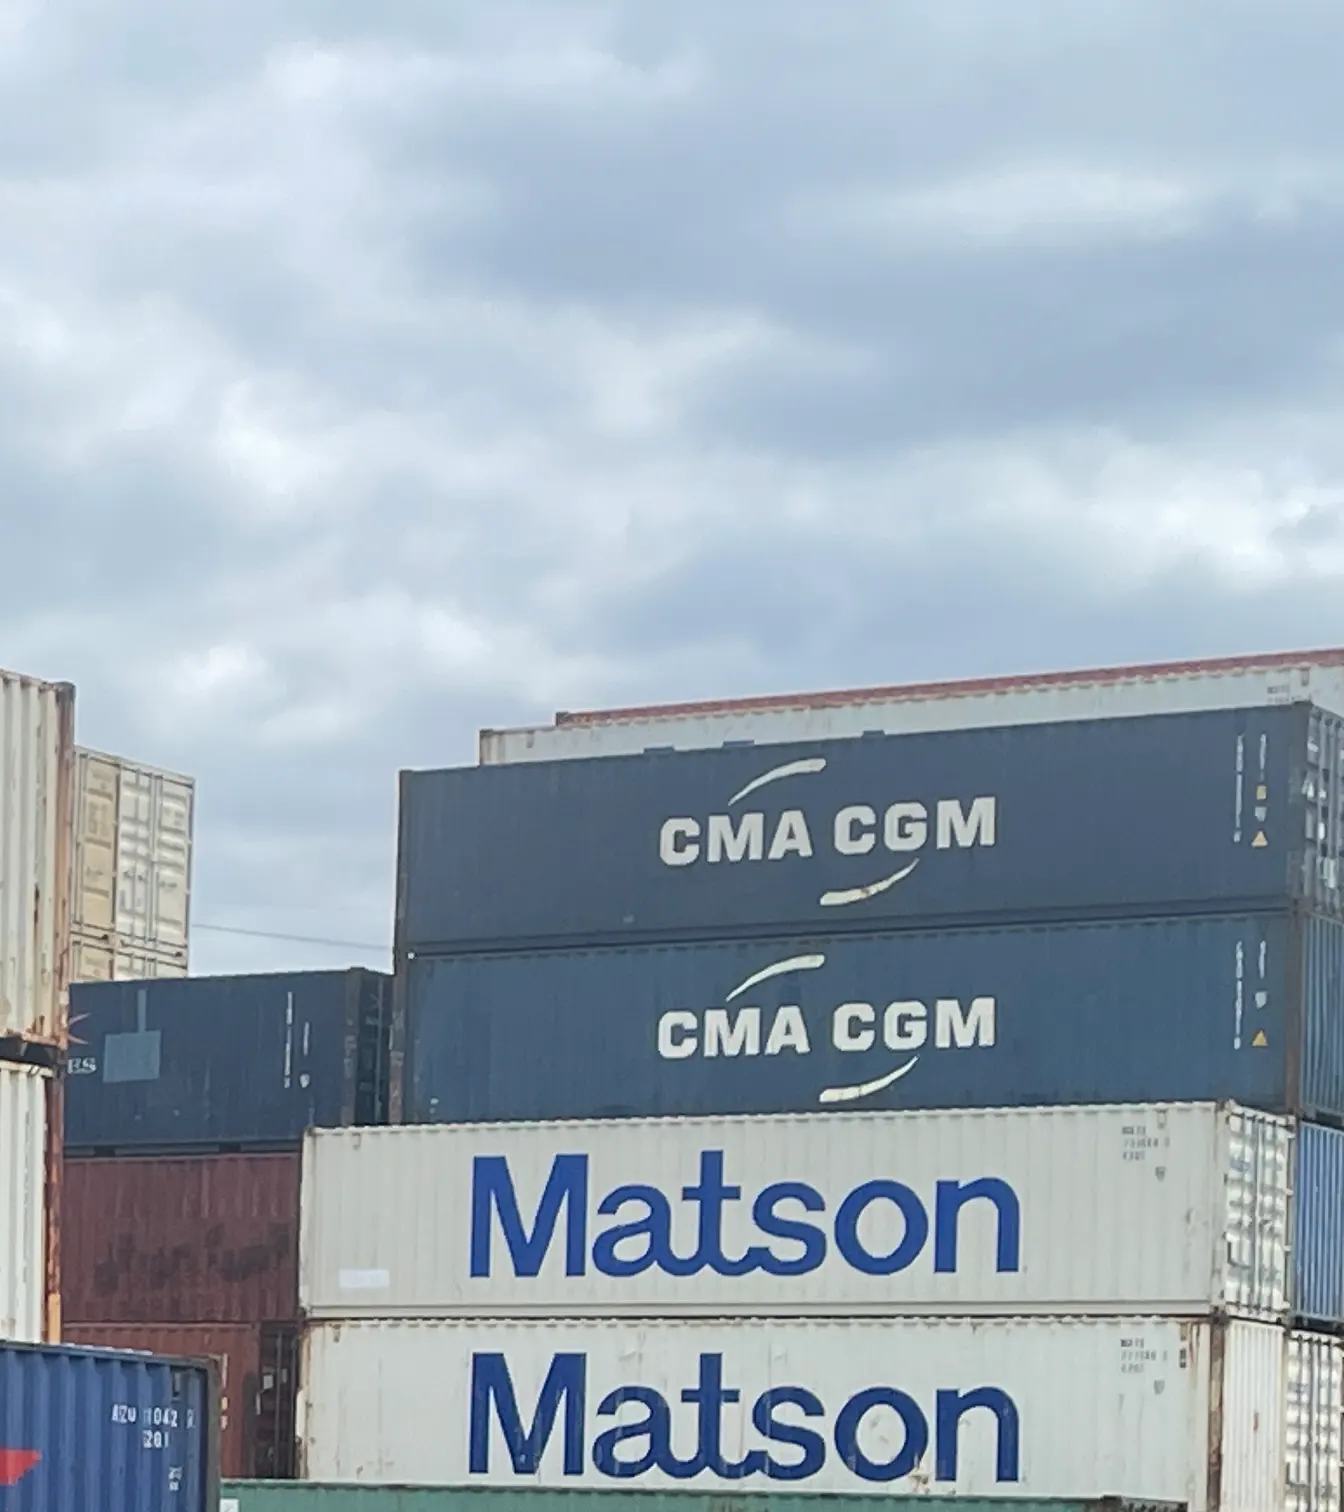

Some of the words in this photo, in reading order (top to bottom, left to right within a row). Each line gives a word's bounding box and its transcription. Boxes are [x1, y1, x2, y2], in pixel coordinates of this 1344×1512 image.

[659, 810, 813, 866] CMA
[833, 796, 997, 855] CGM
[656, 1004, 810, 1060] CMA
[831, 996, 997, 1053] CGM
[469, 1149, 1021, 1278] Matson
[468, 1352, 1020, 1484] Matson
